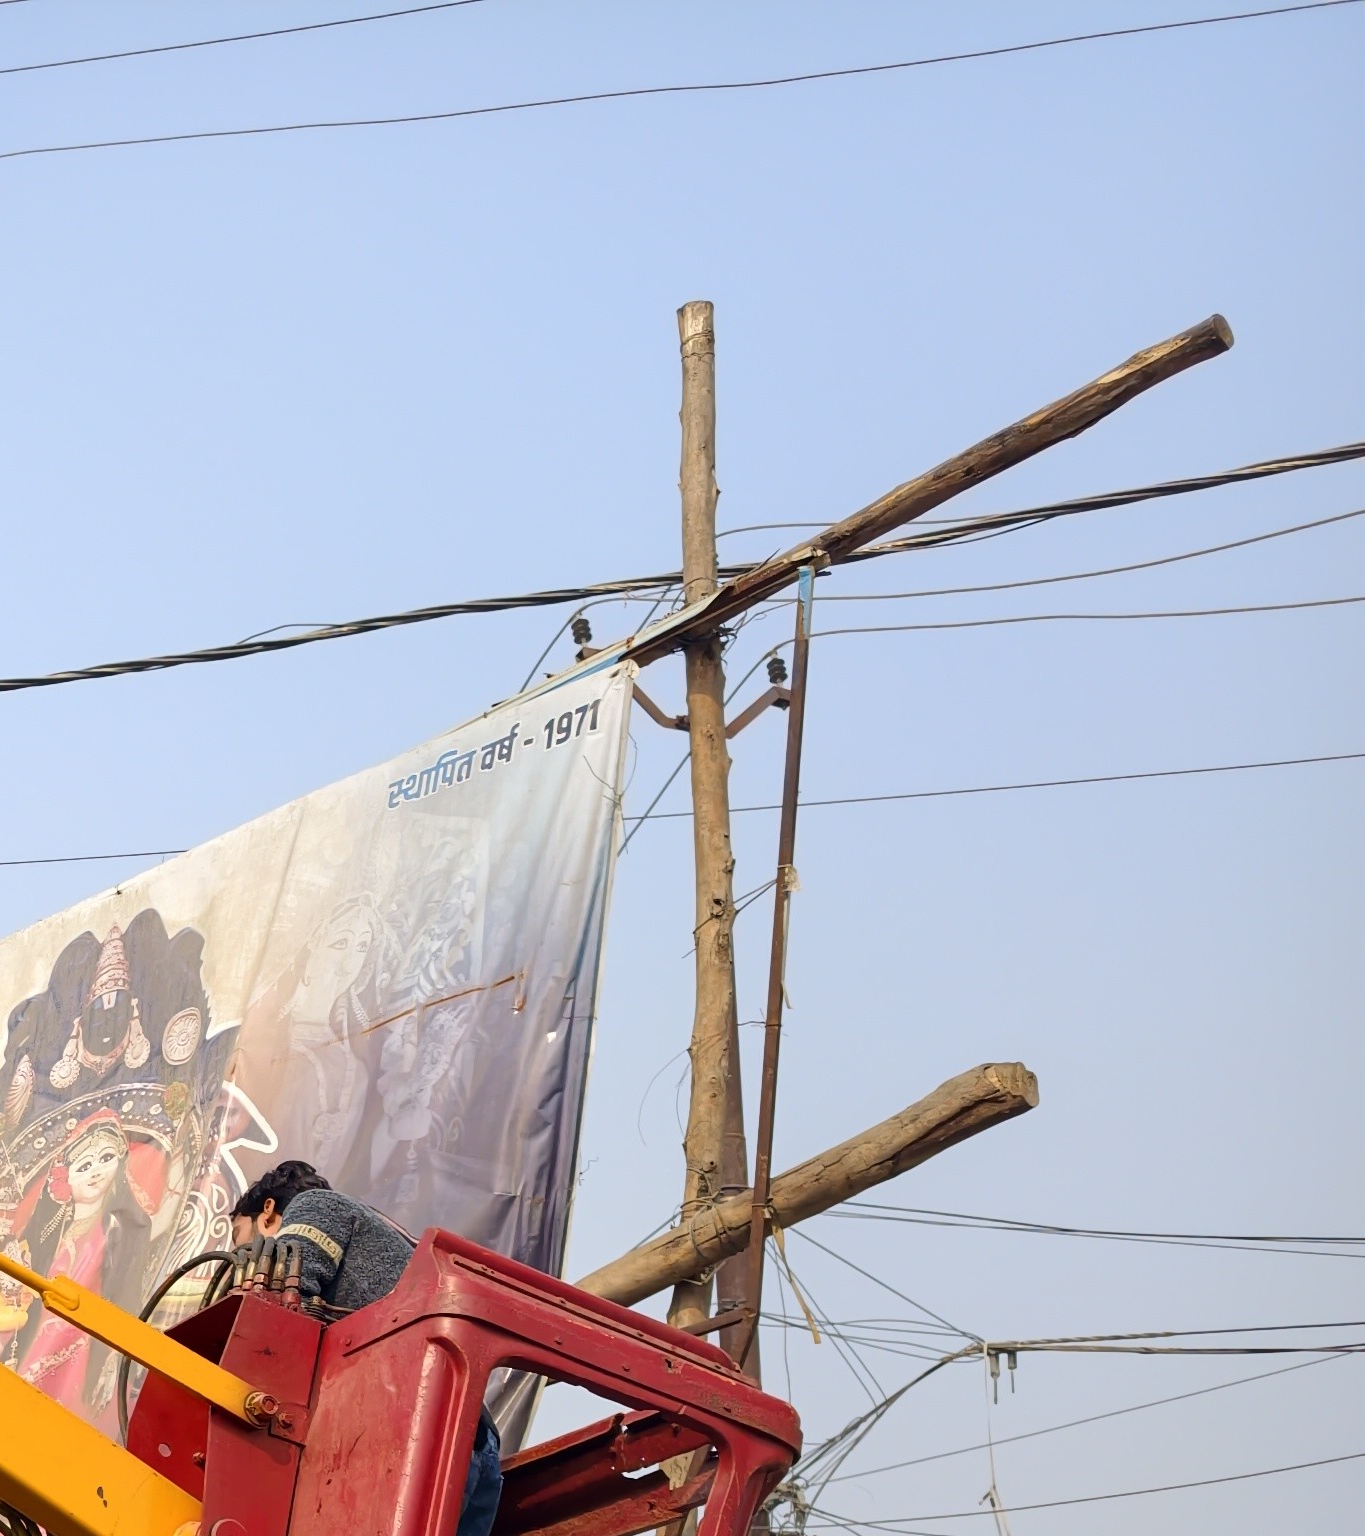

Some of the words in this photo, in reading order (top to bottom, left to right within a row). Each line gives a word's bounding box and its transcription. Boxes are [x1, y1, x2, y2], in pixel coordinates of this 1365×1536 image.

[388, 749, 478, 809] स्थापित
[481, 722, 520, 771] वर्ष
[544, 699, 603, 750] 1971
